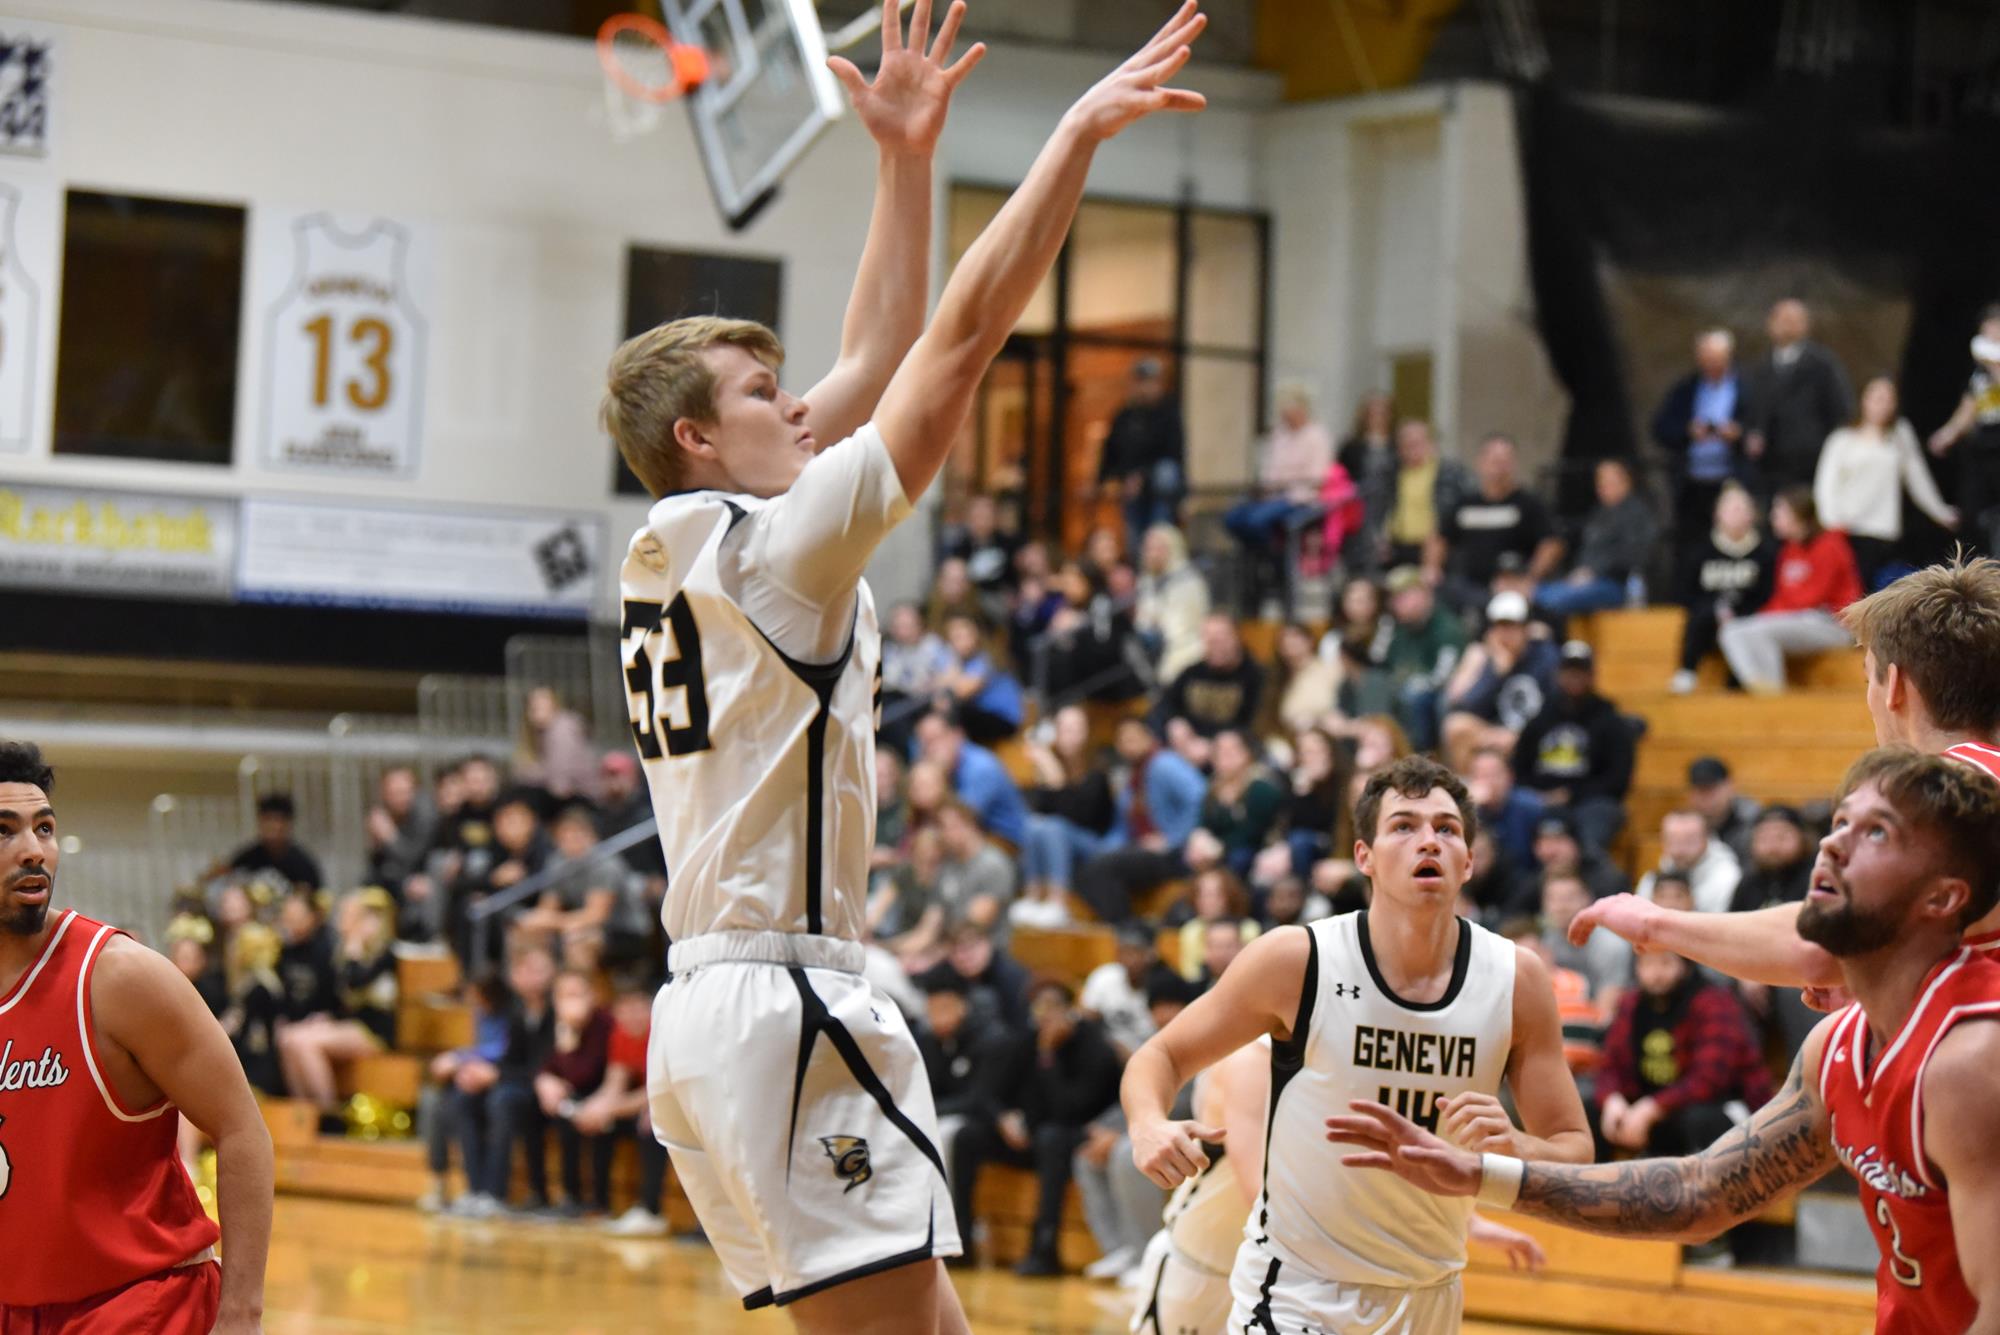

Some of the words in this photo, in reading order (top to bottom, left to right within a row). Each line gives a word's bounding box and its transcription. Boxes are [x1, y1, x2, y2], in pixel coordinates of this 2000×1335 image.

[304, 316, 393, 411] 13
[621, 589, 711, 759] 33
[1353, 1024, 1477, 1078] GENEVA
